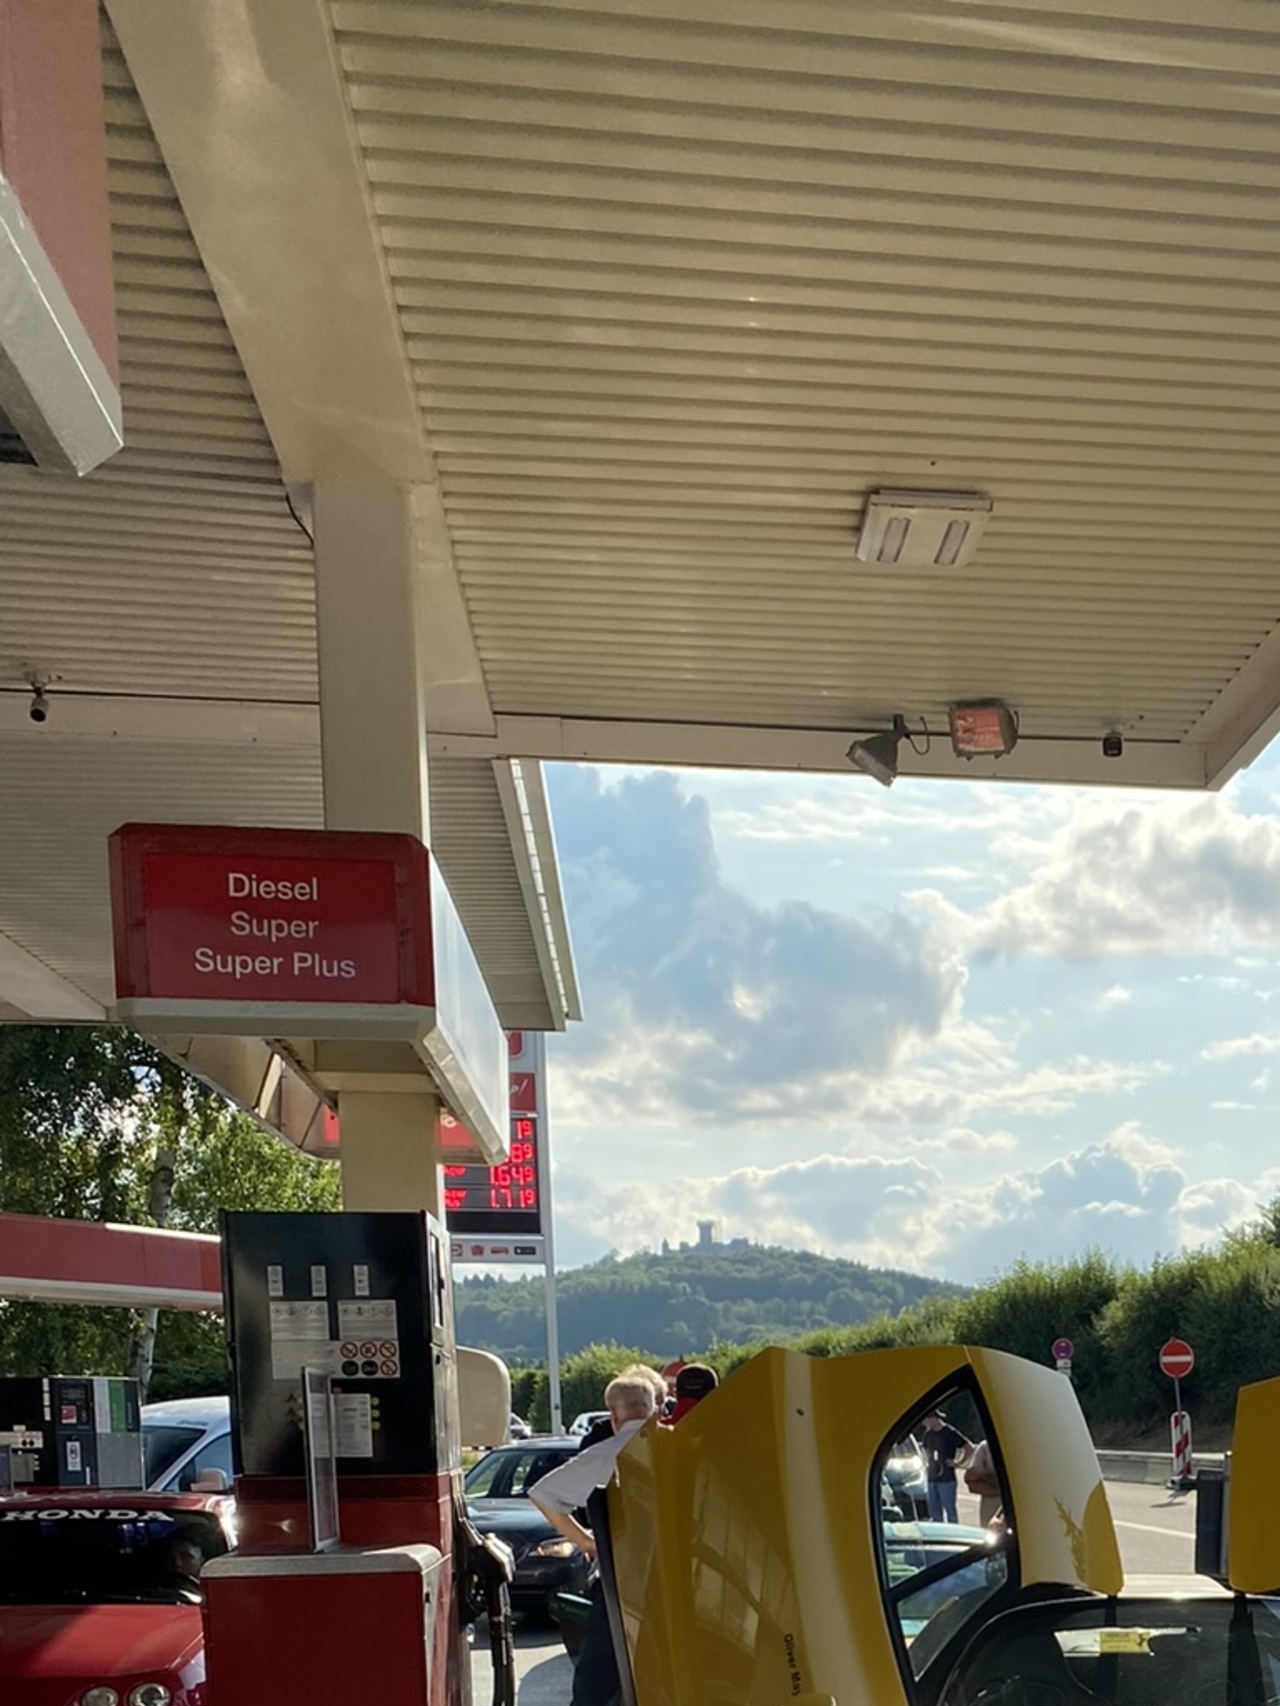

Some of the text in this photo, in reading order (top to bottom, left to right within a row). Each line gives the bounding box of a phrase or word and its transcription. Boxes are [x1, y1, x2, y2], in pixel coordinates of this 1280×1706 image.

[228, 873, 318, 900] Diesel
[231, 911, 319, 943] Super
[195, 948, 356, 979] Super Plus
[2, 1509, 174, 1521] HONDA
